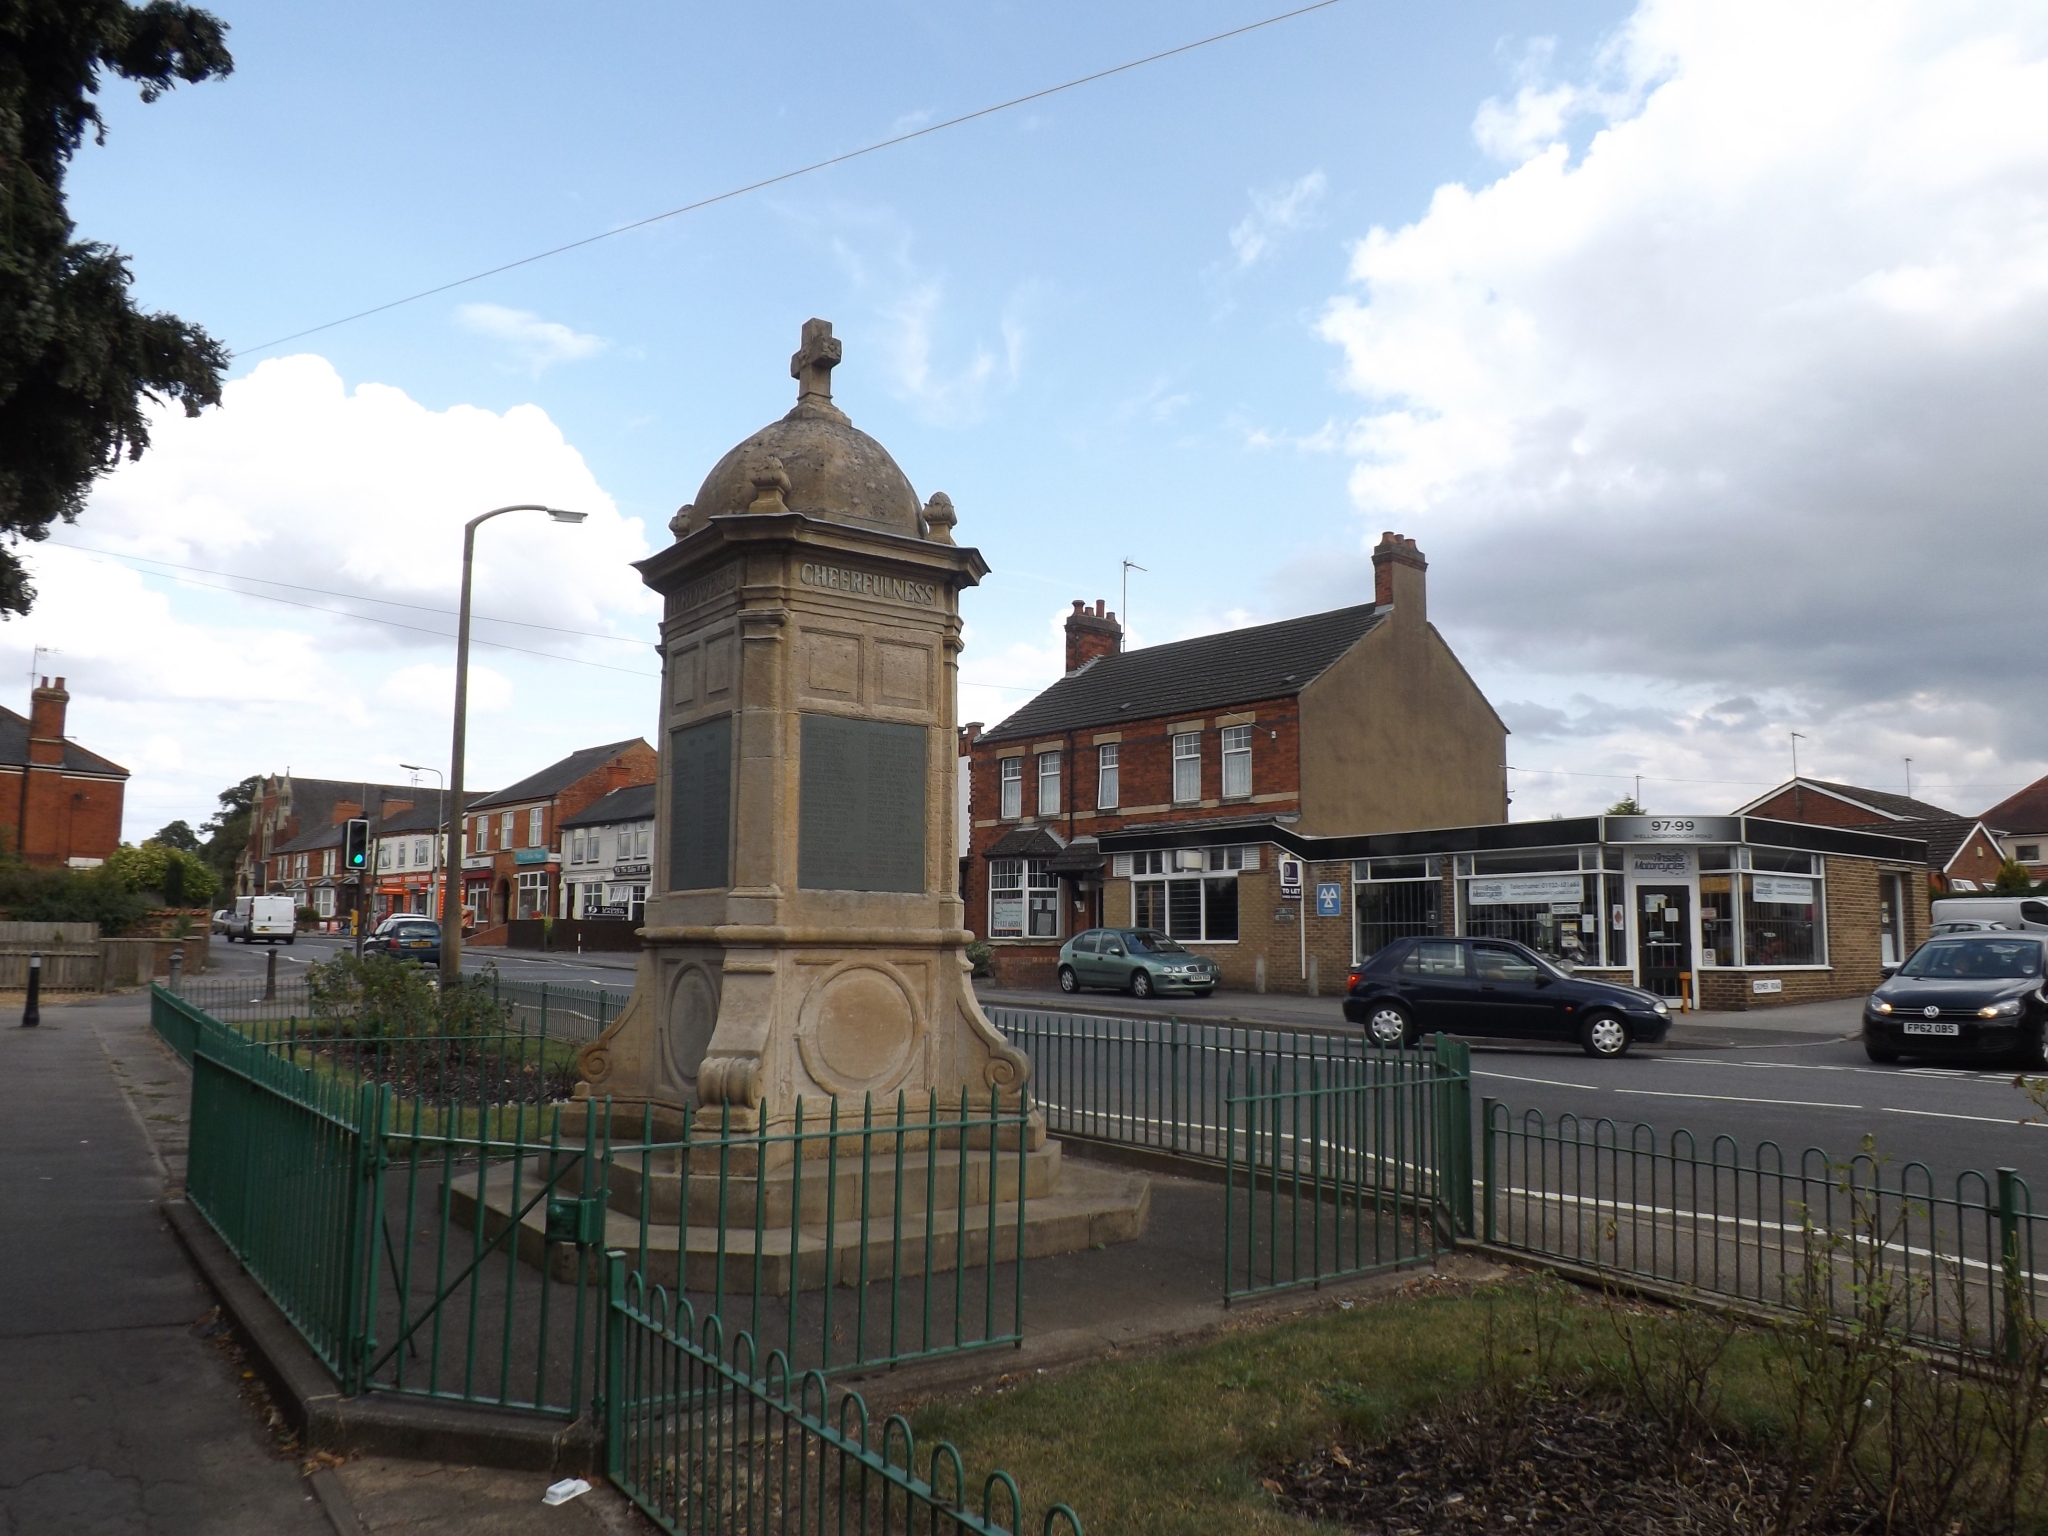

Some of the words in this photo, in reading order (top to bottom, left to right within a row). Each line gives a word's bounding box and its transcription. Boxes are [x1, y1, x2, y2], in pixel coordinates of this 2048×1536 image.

[672, 565, 736, 615] PROWESS
[800, 563, 935, 606] CHEERFULNESS
[1651, 820, 1695, 832] 97-99
[1634, 860, 1685, 873] Motorcycles
[1907, 1023, 1933, 1033] FP62
